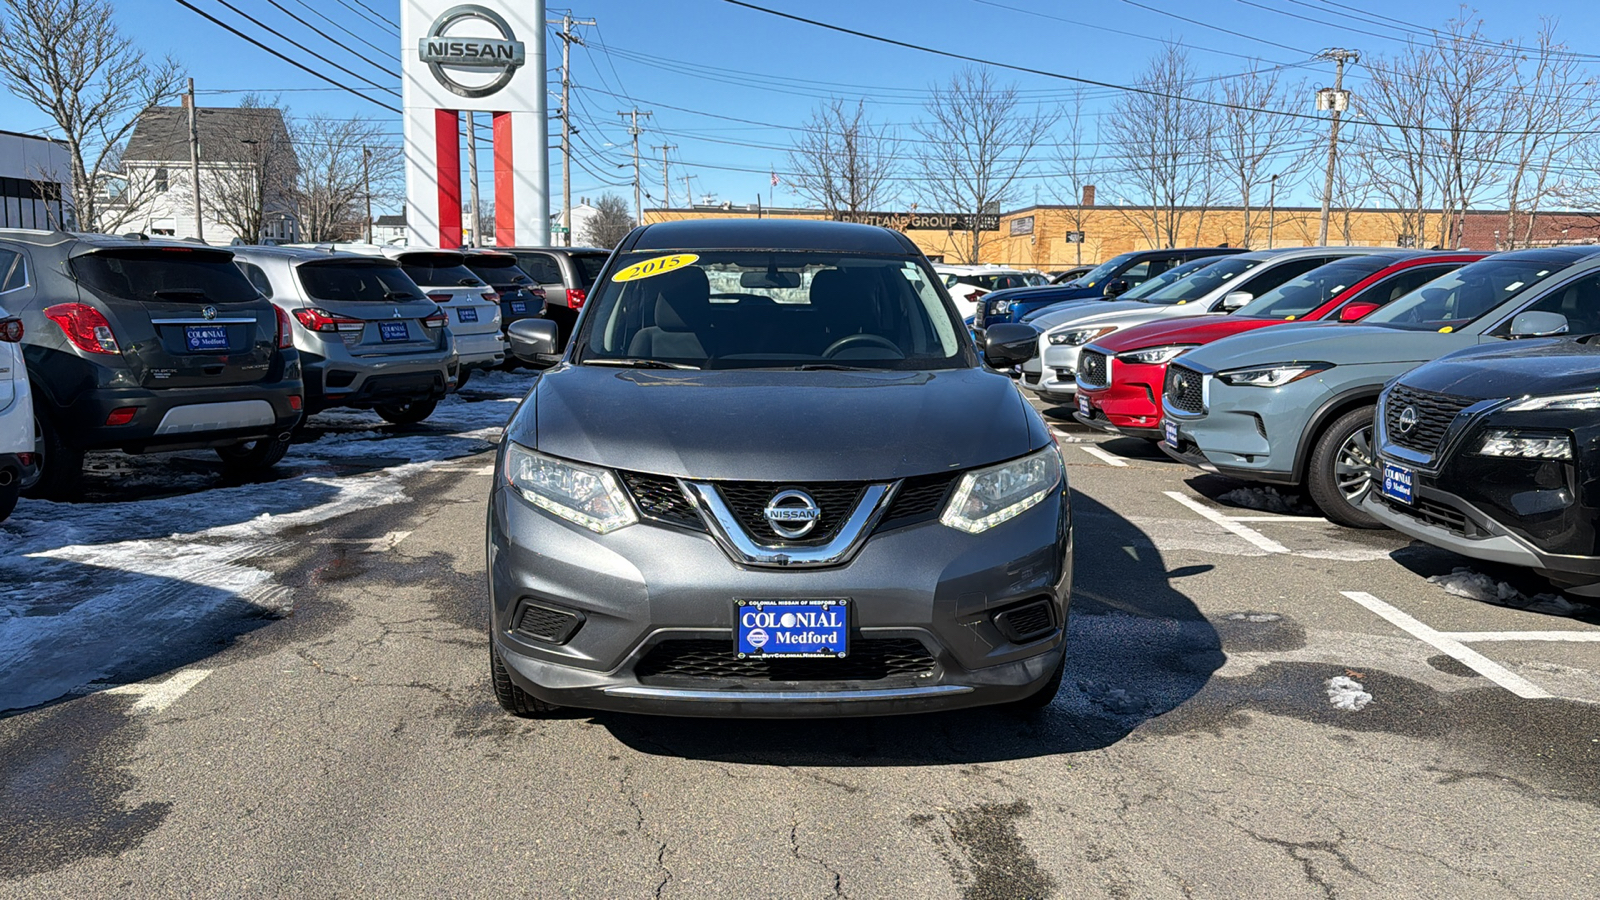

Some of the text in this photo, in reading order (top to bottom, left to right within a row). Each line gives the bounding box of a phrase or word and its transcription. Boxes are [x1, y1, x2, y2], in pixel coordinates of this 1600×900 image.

[427, 42, 513, 59] NISSAN
[911, 215, 958, 228] GROUP
[629, 256, 681, 278] 2015
[187, 331, 226, 339] COLONIAL
[1385, 468, 1412, 486] COLONIAL
[1393, 481, 1411, 496] Medford
[770, 510, 815, 519] NISSAN
[742, 612, 843, 628] COLONIAL
[776, 631, 838, 645] Medford
